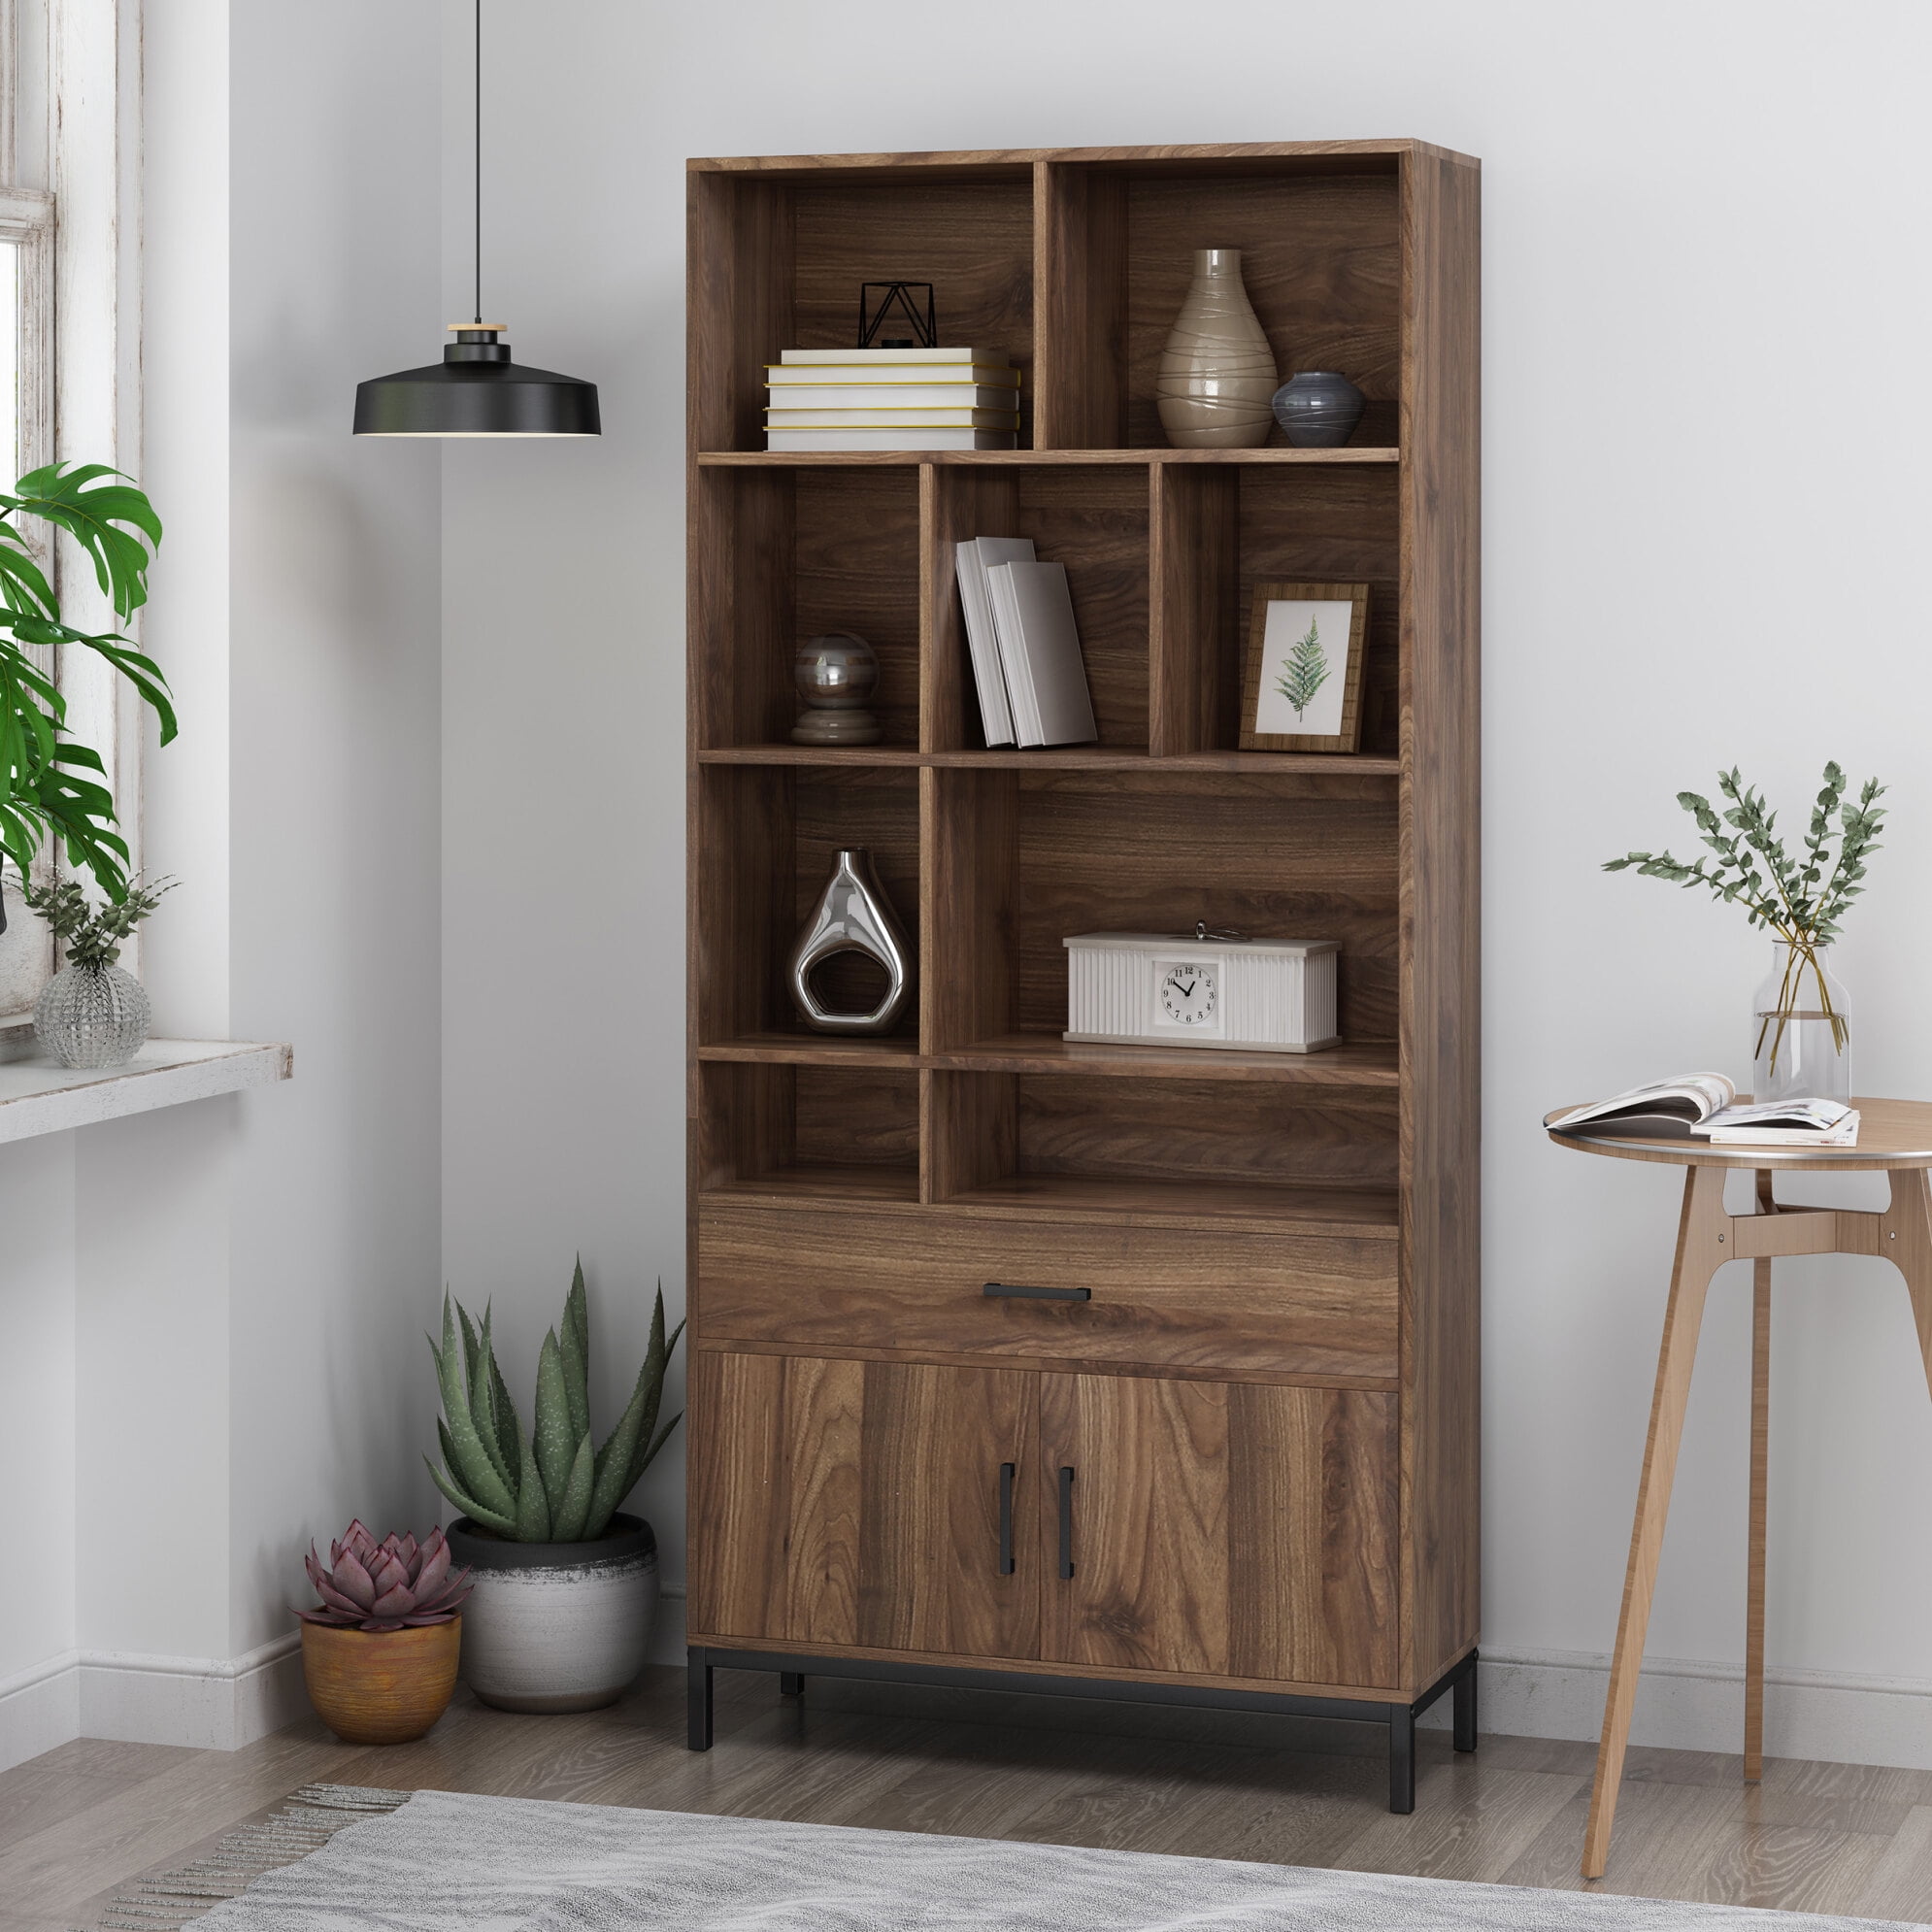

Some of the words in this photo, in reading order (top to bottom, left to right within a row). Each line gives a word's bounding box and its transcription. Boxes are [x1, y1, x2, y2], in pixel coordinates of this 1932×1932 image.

[1175, 969, 1183, 978] 11
[1184, 966, 1194, 975] 12
[1206, 979, 1211, 987] 2
[1163, 989, 1169, 998] 9
[1209, 991, 1215, 1000] 3
[1166, 1000, 1172, 1010] 8
[1206, 1002, 1211, 1011] 4
[1175, 1010, 1181, 1018] 7
[1197, 1011, 1203, 1019] 5
